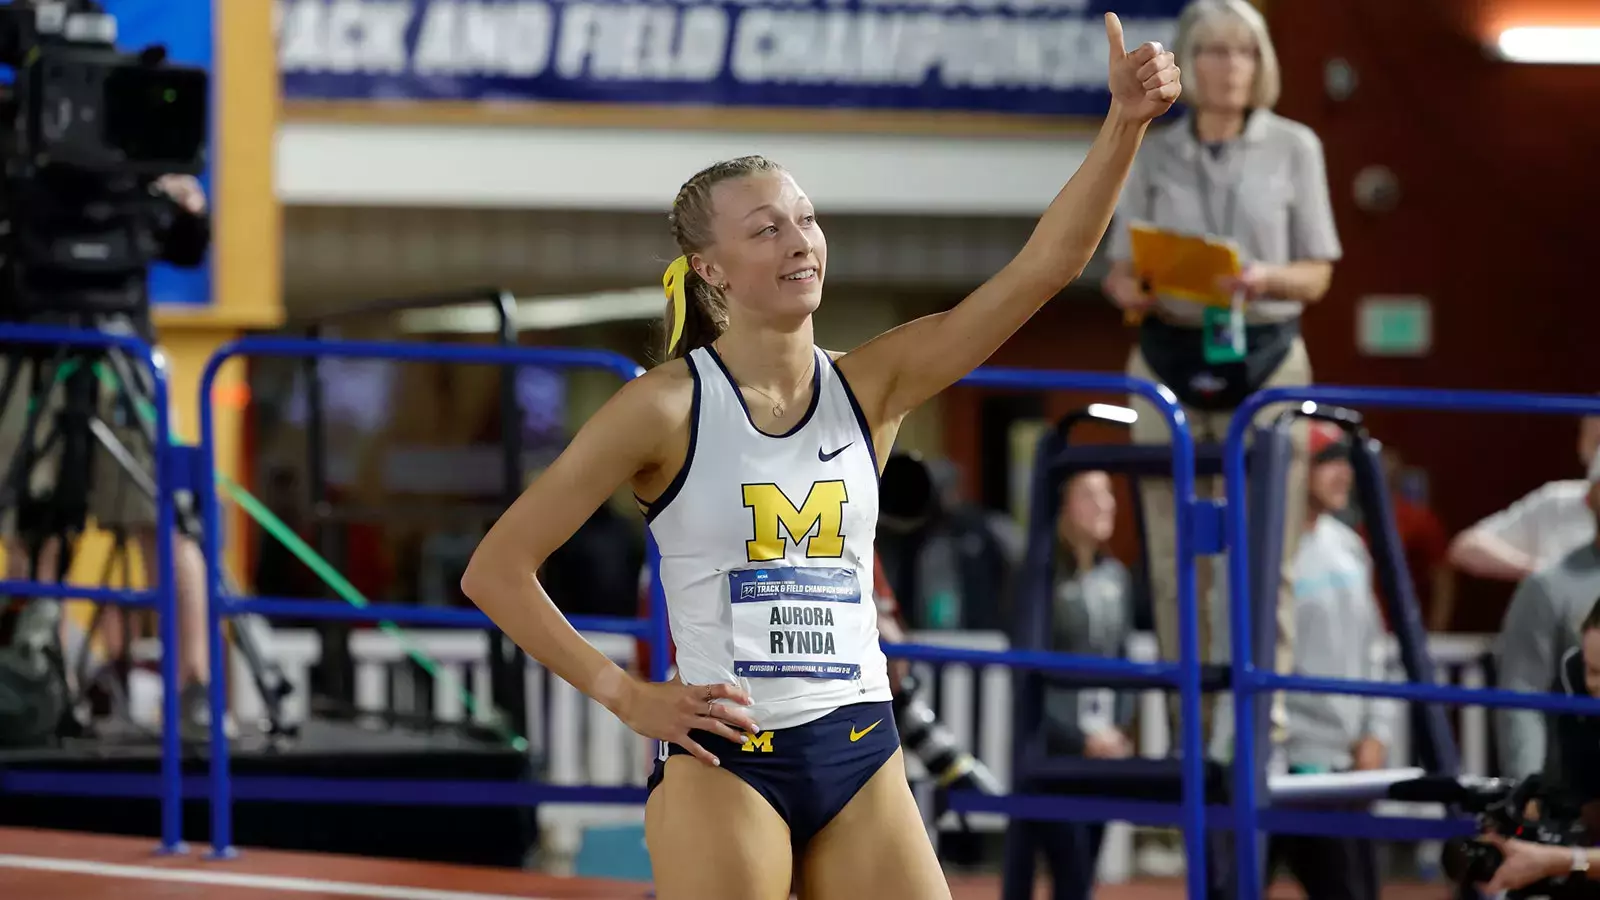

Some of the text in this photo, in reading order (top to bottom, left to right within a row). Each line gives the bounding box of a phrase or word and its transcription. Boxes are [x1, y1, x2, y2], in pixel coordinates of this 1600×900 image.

[280, 0, 411, 74] ACK
[413, 0, 556, 77] AND
[554, 3, 731, 82] FIELD
[741, 479, 849, 563] M
[757, 584, 780, 593] TRACK
[786, 584, 805, 593] FIELD
[804, 584, 853, 595] CHAMPIONSHIPS
[769, 606, 835, 627] AURORA
[769, 630, 836, 656] RYNDA
[741, 730, 775, 753] M
